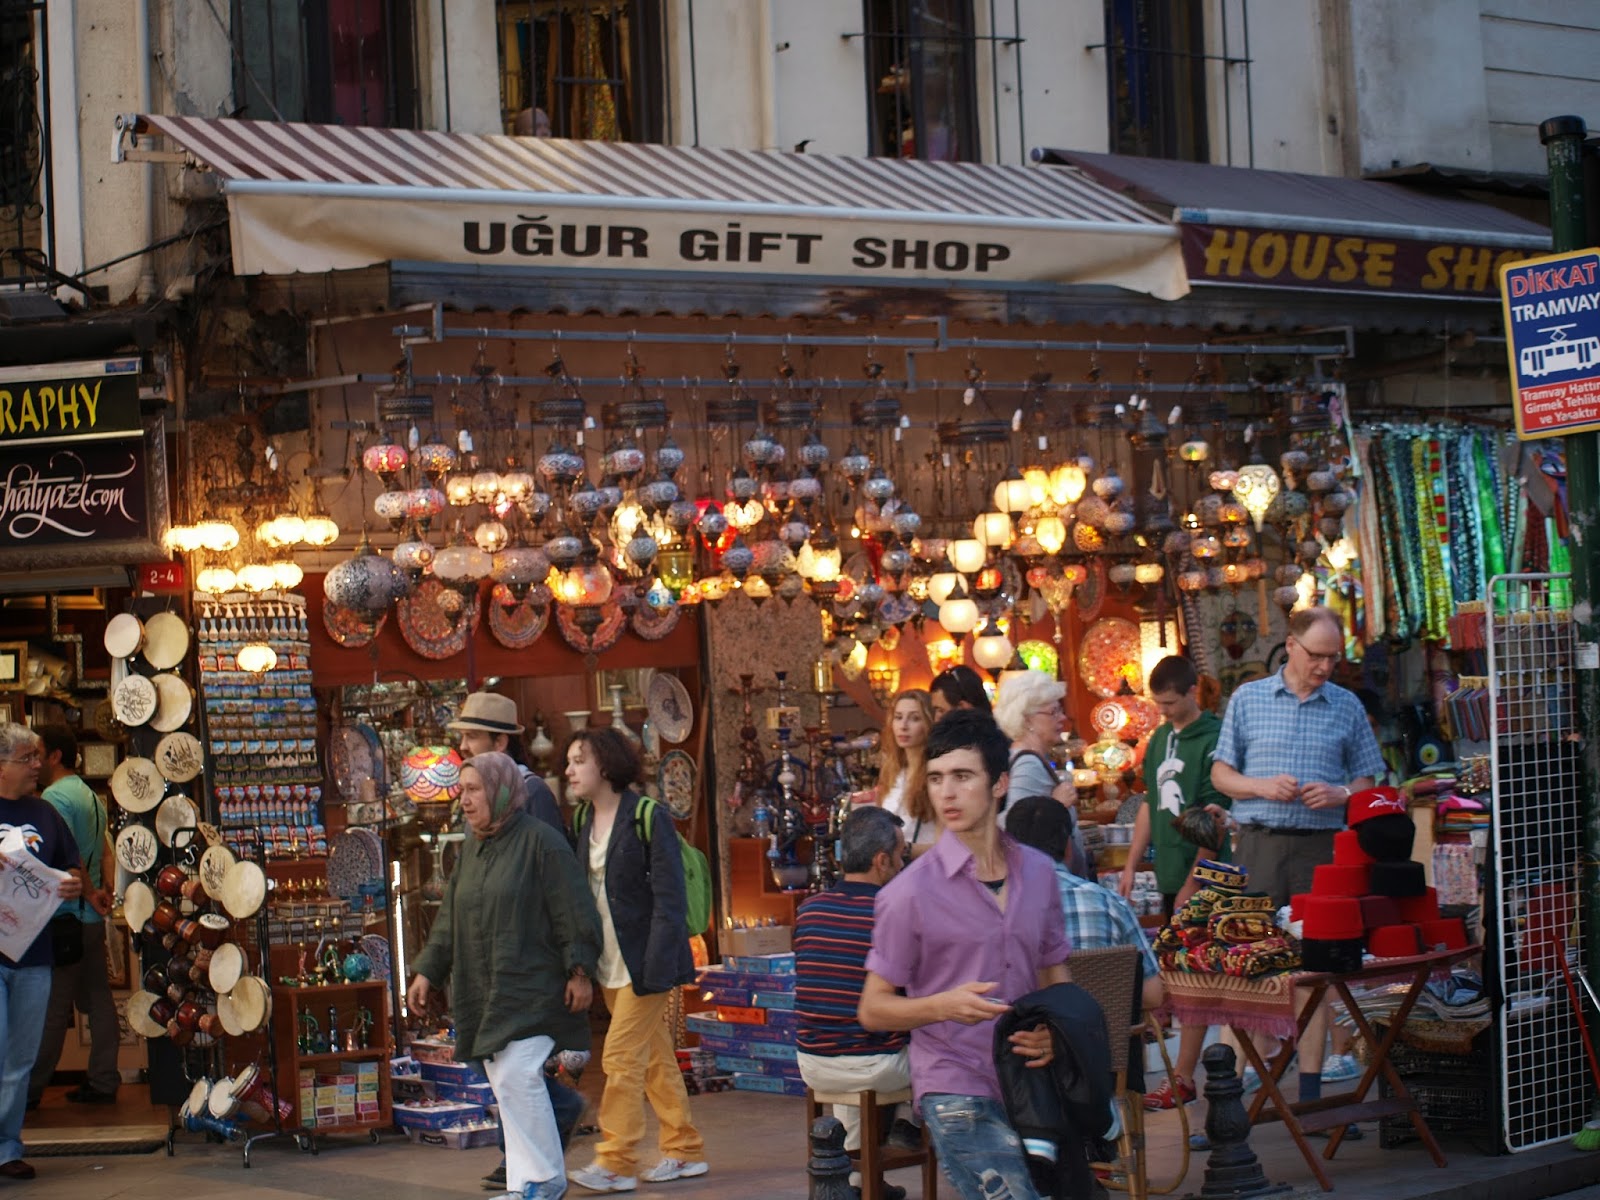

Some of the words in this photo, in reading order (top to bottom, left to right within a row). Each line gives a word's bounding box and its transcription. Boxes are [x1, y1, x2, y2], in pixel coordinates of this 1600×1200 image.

[463, 214, 649, 258] UĞUR
[679, 222, 823, 265] GİFT
[851, 236, 1011, 273] SHOP
[1204, 228, 1397, 288] HOUSE
[1420, 244, 1546, 292] SHO
[1510, 261, 1598, 298] DİKKAT
[1511, 292, 1600, 322] TRAMVAY
[1521, 386, 1567, 402] Tramvay
[1524, 399, 1564, 414] Girmek
[1539, 414, 1553, 424] ve
[1553, 408, 1598, 422] Yasaktır
[150, 568, 174, 584] 2-4
